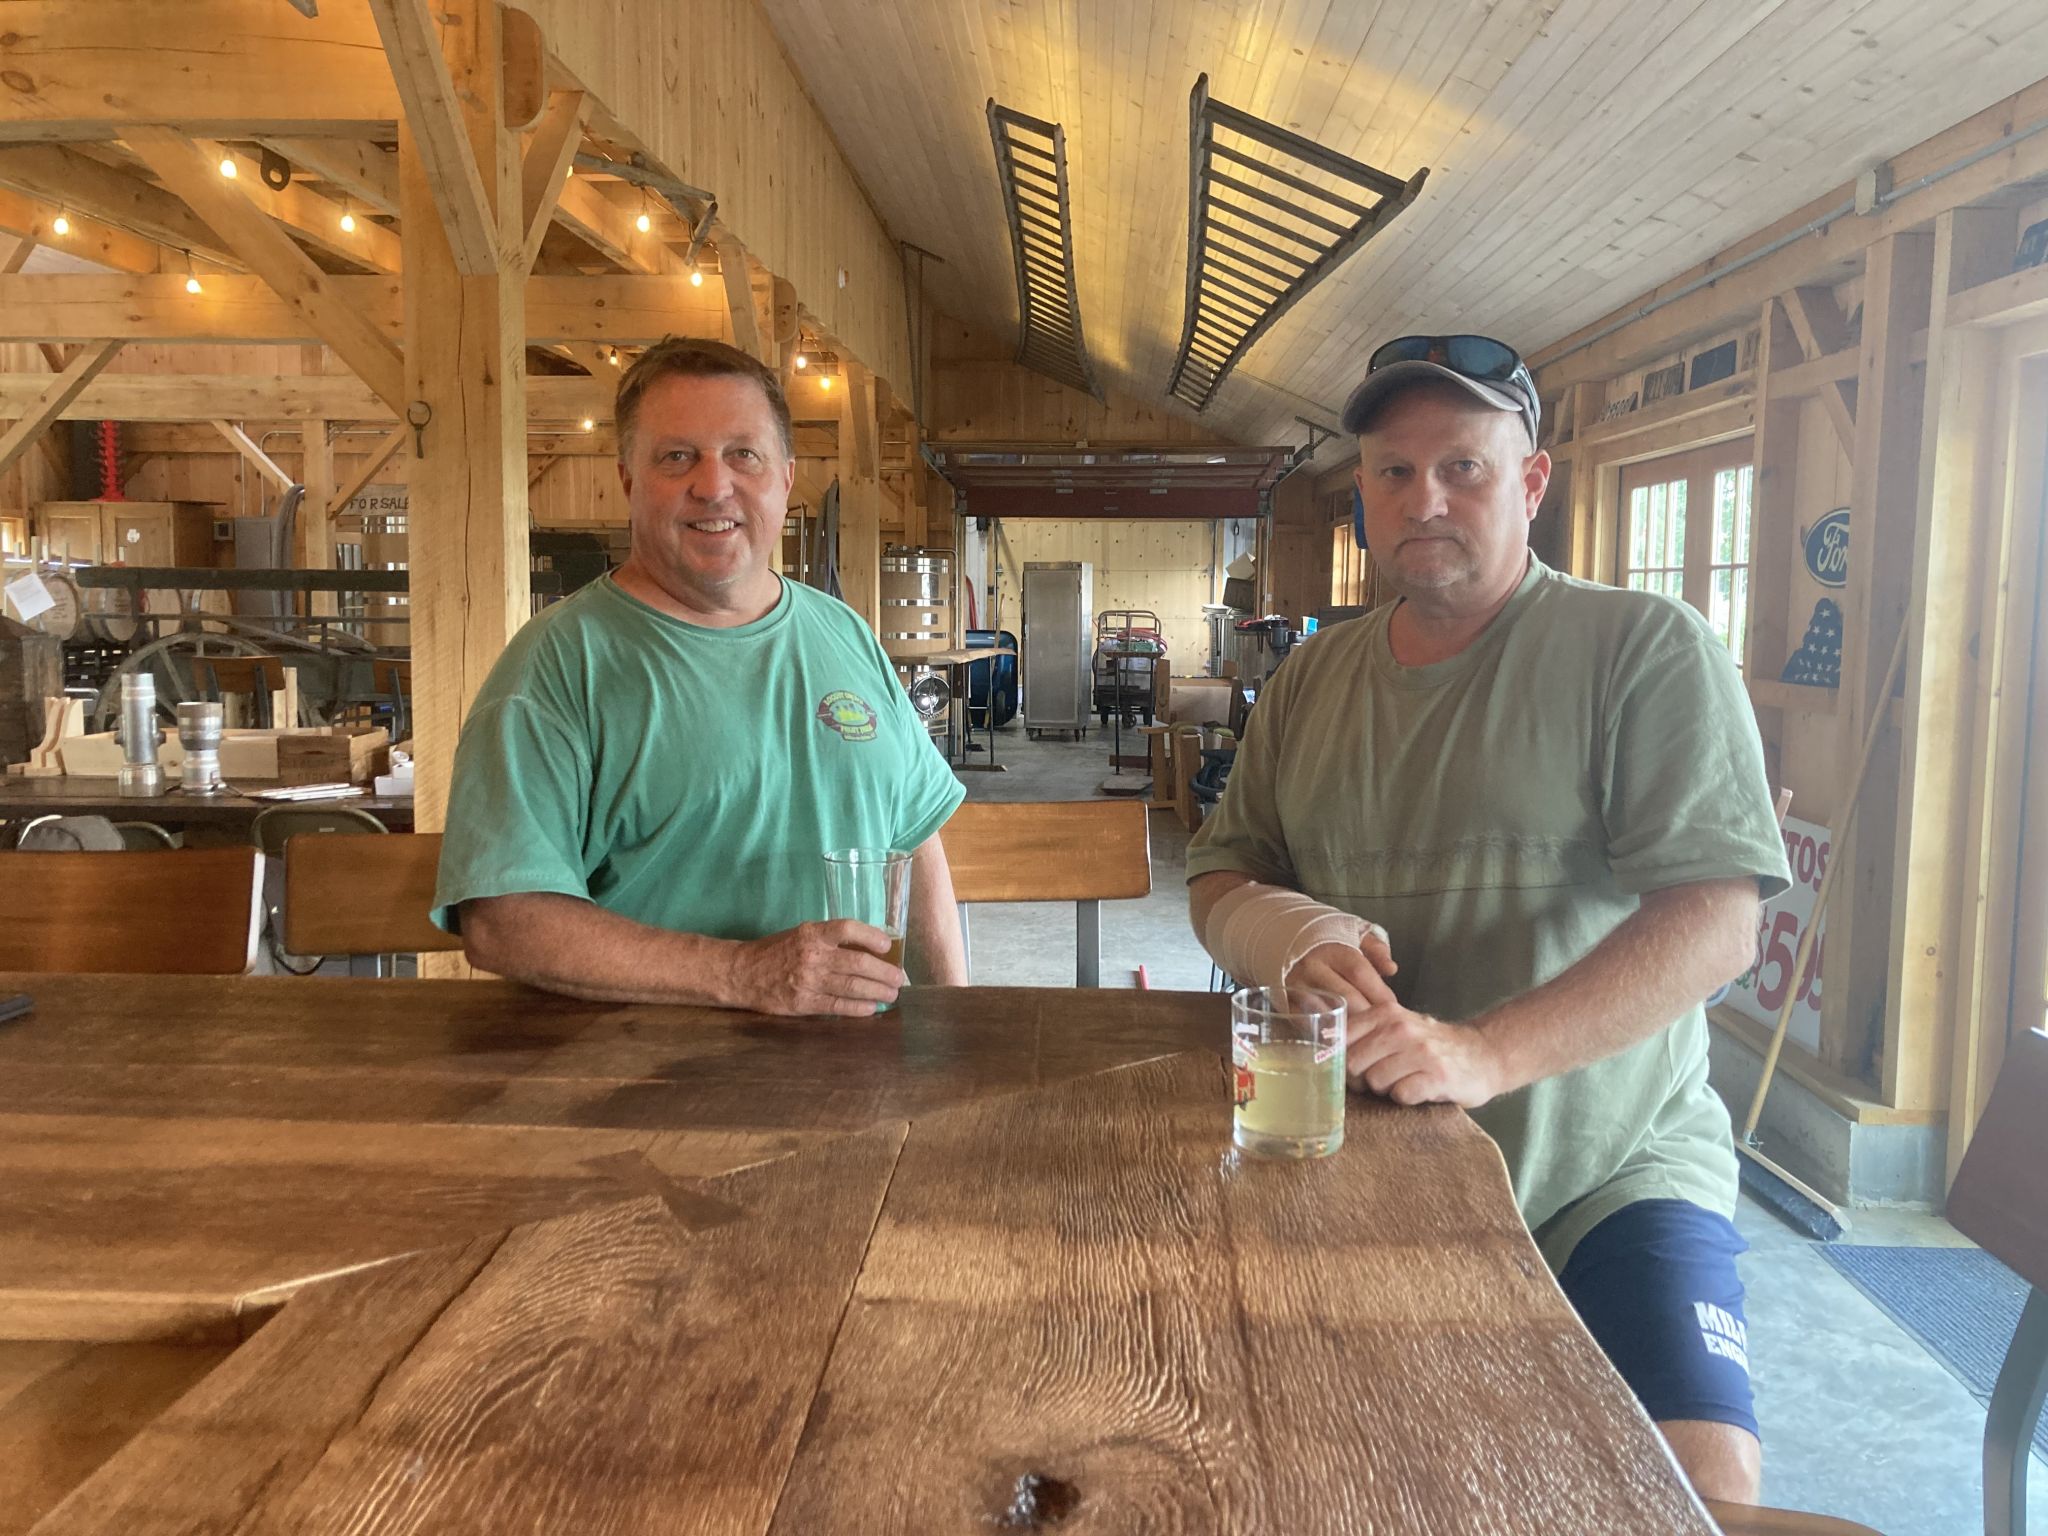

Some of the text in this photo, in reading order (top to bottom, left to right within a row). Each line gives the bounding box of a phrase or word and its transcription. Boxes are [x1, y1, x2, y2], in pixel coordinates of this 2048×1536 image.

[350, 498, 378, 510] FOR
[1817, 521, 1849, 572] For
[1781, 828, 1830, 893] TOS
